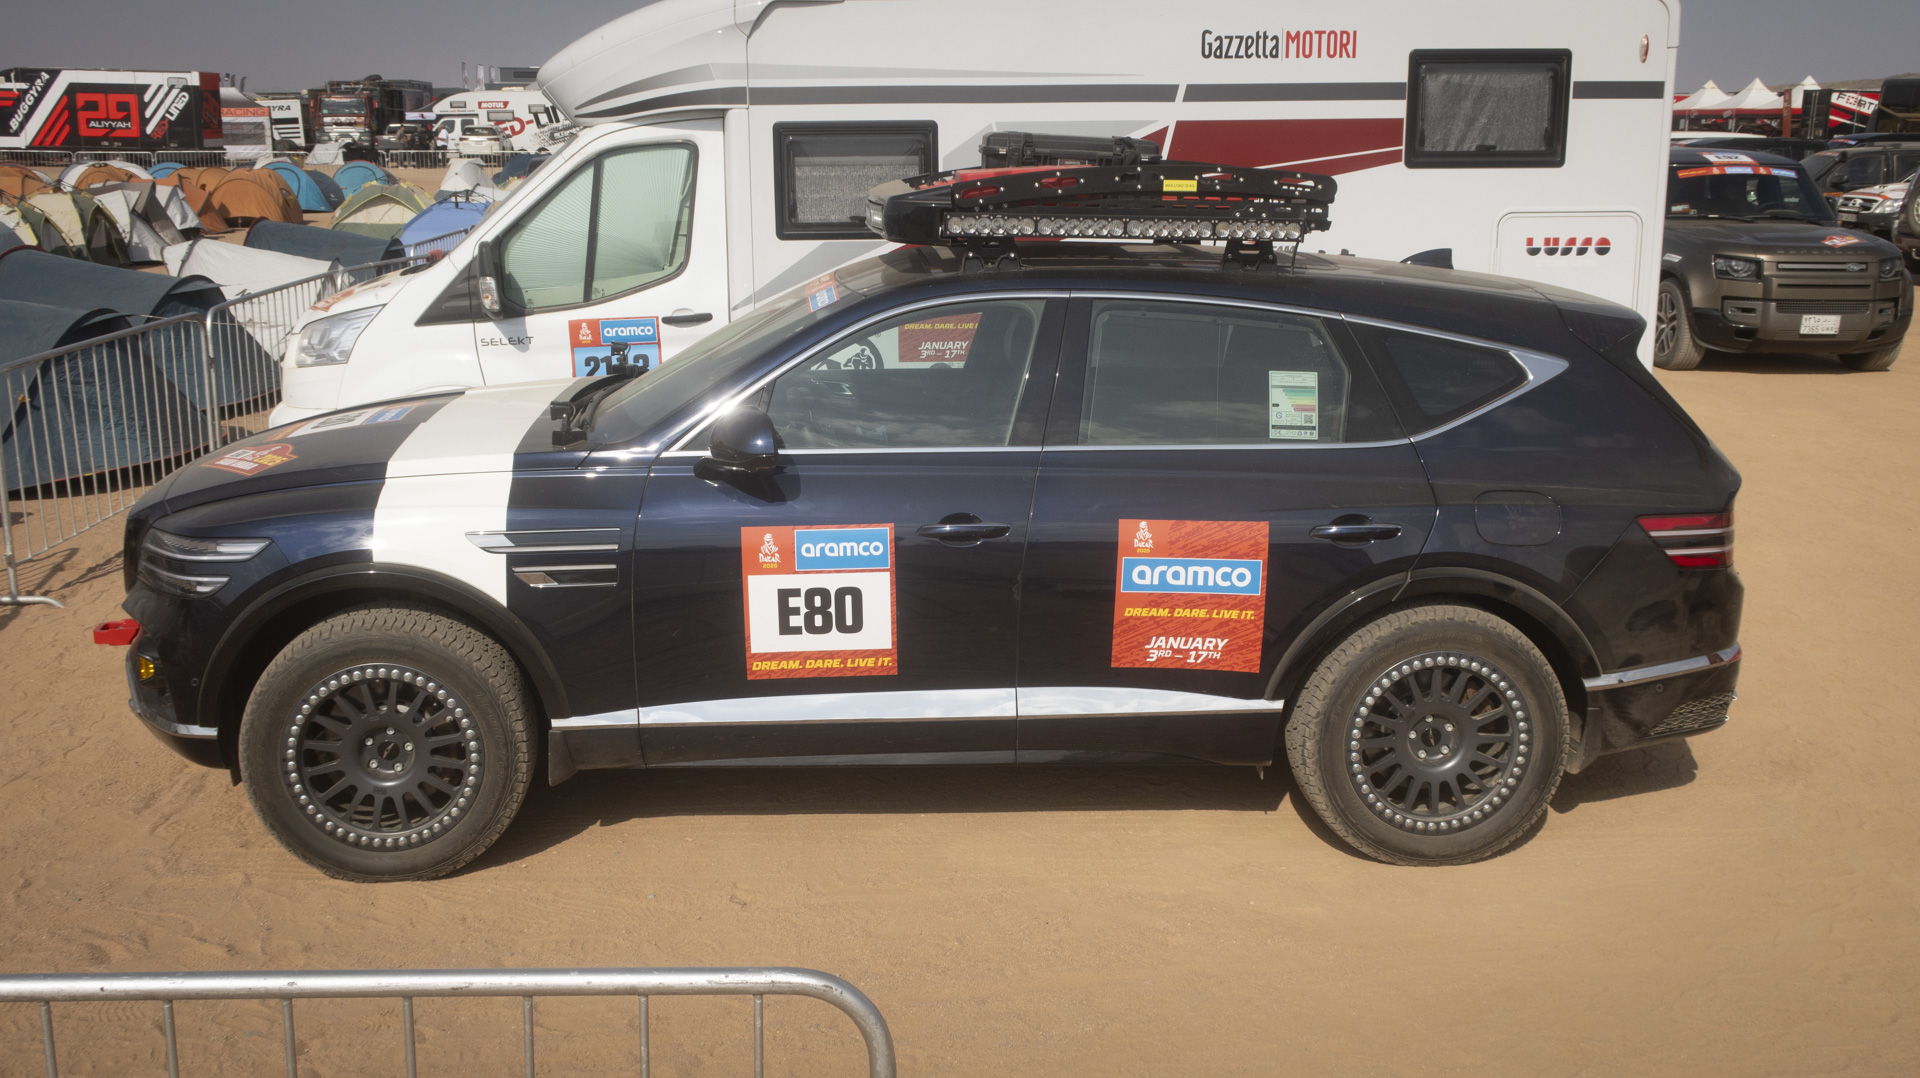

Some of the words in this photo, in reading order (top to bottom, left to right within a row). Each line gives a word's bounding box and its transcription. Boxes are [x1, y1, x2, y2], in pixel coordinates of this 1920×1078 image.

[1201, 29, 1280, 59] Gazzetta
[1285, 29, 1358, 59] MOTORI
[9, 71, 50, 131] BUGGYRA
[480, 101, 505, 109] MOTUL
[75, 92, 141, 138] 29
[88, 120, 132, 128] ALIYYAH
[603, 326, 654, 337] aramco
[481, 336, 535, 347] SELEKT
[918, 341, 969, 350] JANUARY
[801, 541, 884, 558] aramco
[1133, 538, 1154, 549] DAKAR
[758, 553, 782, 563] DAKAR
[1132, 565, 1252, 588] aramco
[777, 586, 864, 636] E80
[1124, 608, 1171, 617] DREAM.
[1173, 608, 1210, 618] DARE.
[1212, 609, 1240, 619] LIVE
[1241, 610, 1255, 619] IT.
[1144, 636, 1229, 650] JANUARY
[1146, 650, 1172, 662] 3RD
[1186, 651, 1221, 663] 17TH
[752, 660, 803, 671] DREAM.
[805, 658, 844, 669] DARE.
[846, 657, 876, 668] LIVE
[877, 657, 893, 667] IT.
